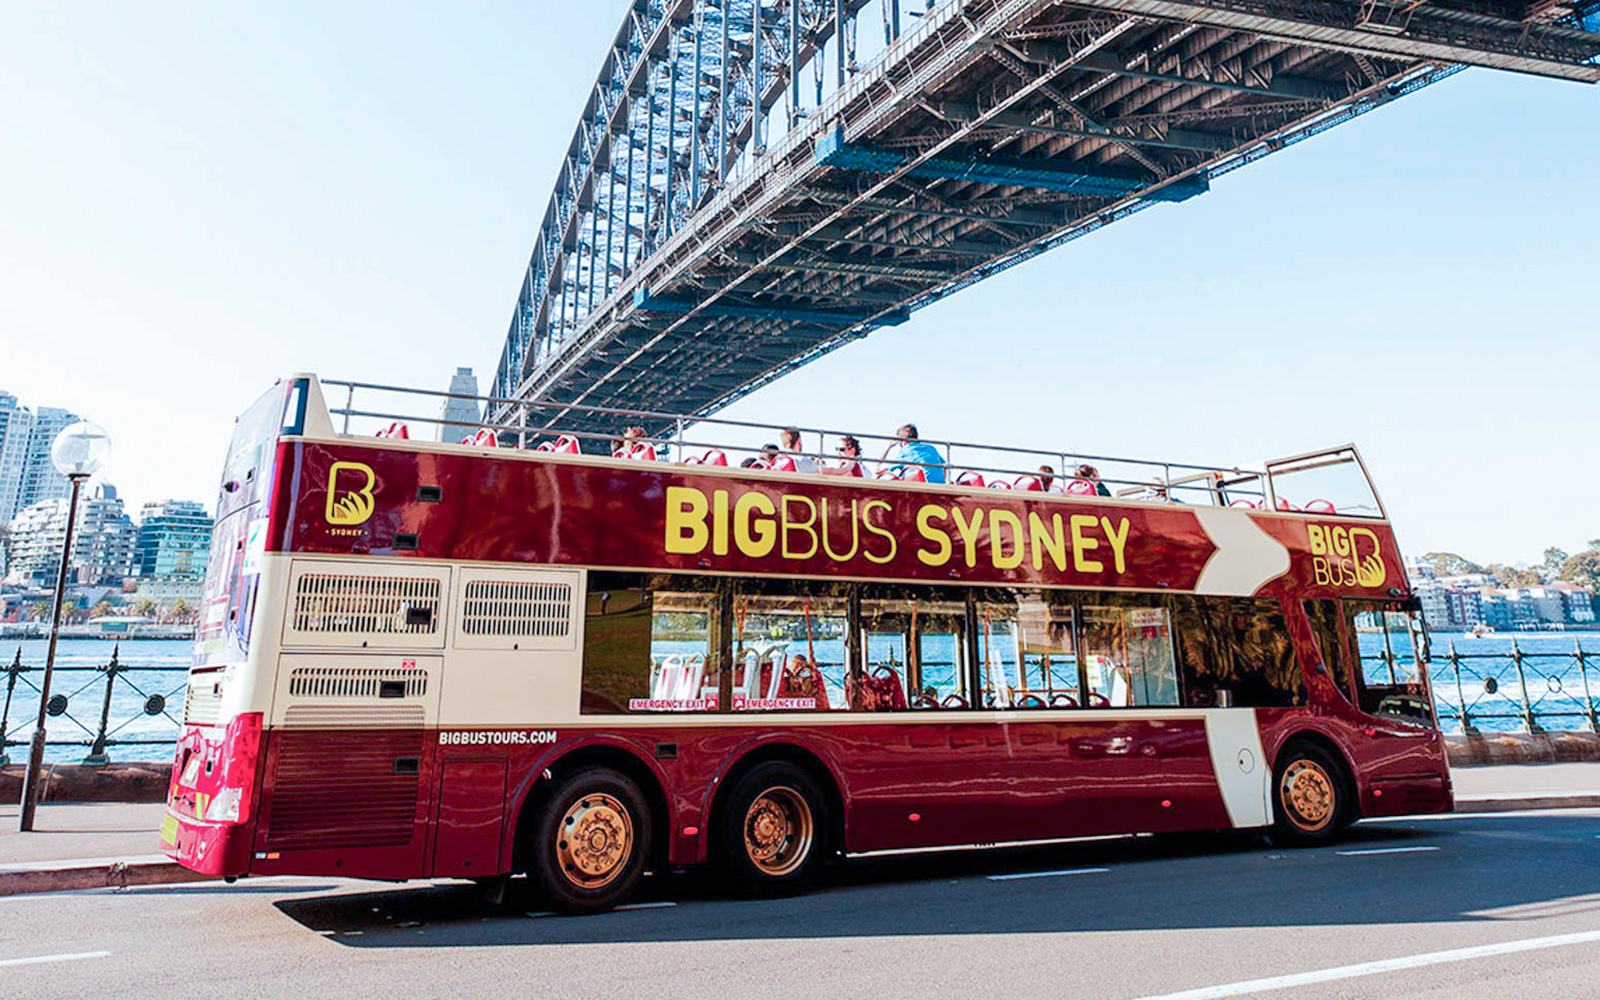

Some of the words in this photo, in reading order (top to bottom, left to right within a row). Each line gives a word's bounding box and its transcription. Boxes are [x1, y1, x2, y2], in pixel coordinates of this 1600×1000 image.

[916, 504, 1130, 574] SYDNEY
[1307, 524, 1350, 557] BIG
[1313, 557, 1356, 587] BUS
[631, 699, 685, 710] EMERGENCY
[686, 699, 705, 709] EXIT
[746, 699, 794, 709] EMERGENCY
[796, 698, 815, 708] EXIT
[440, 730, 557, 745] BIGBUSTOURS.COM
